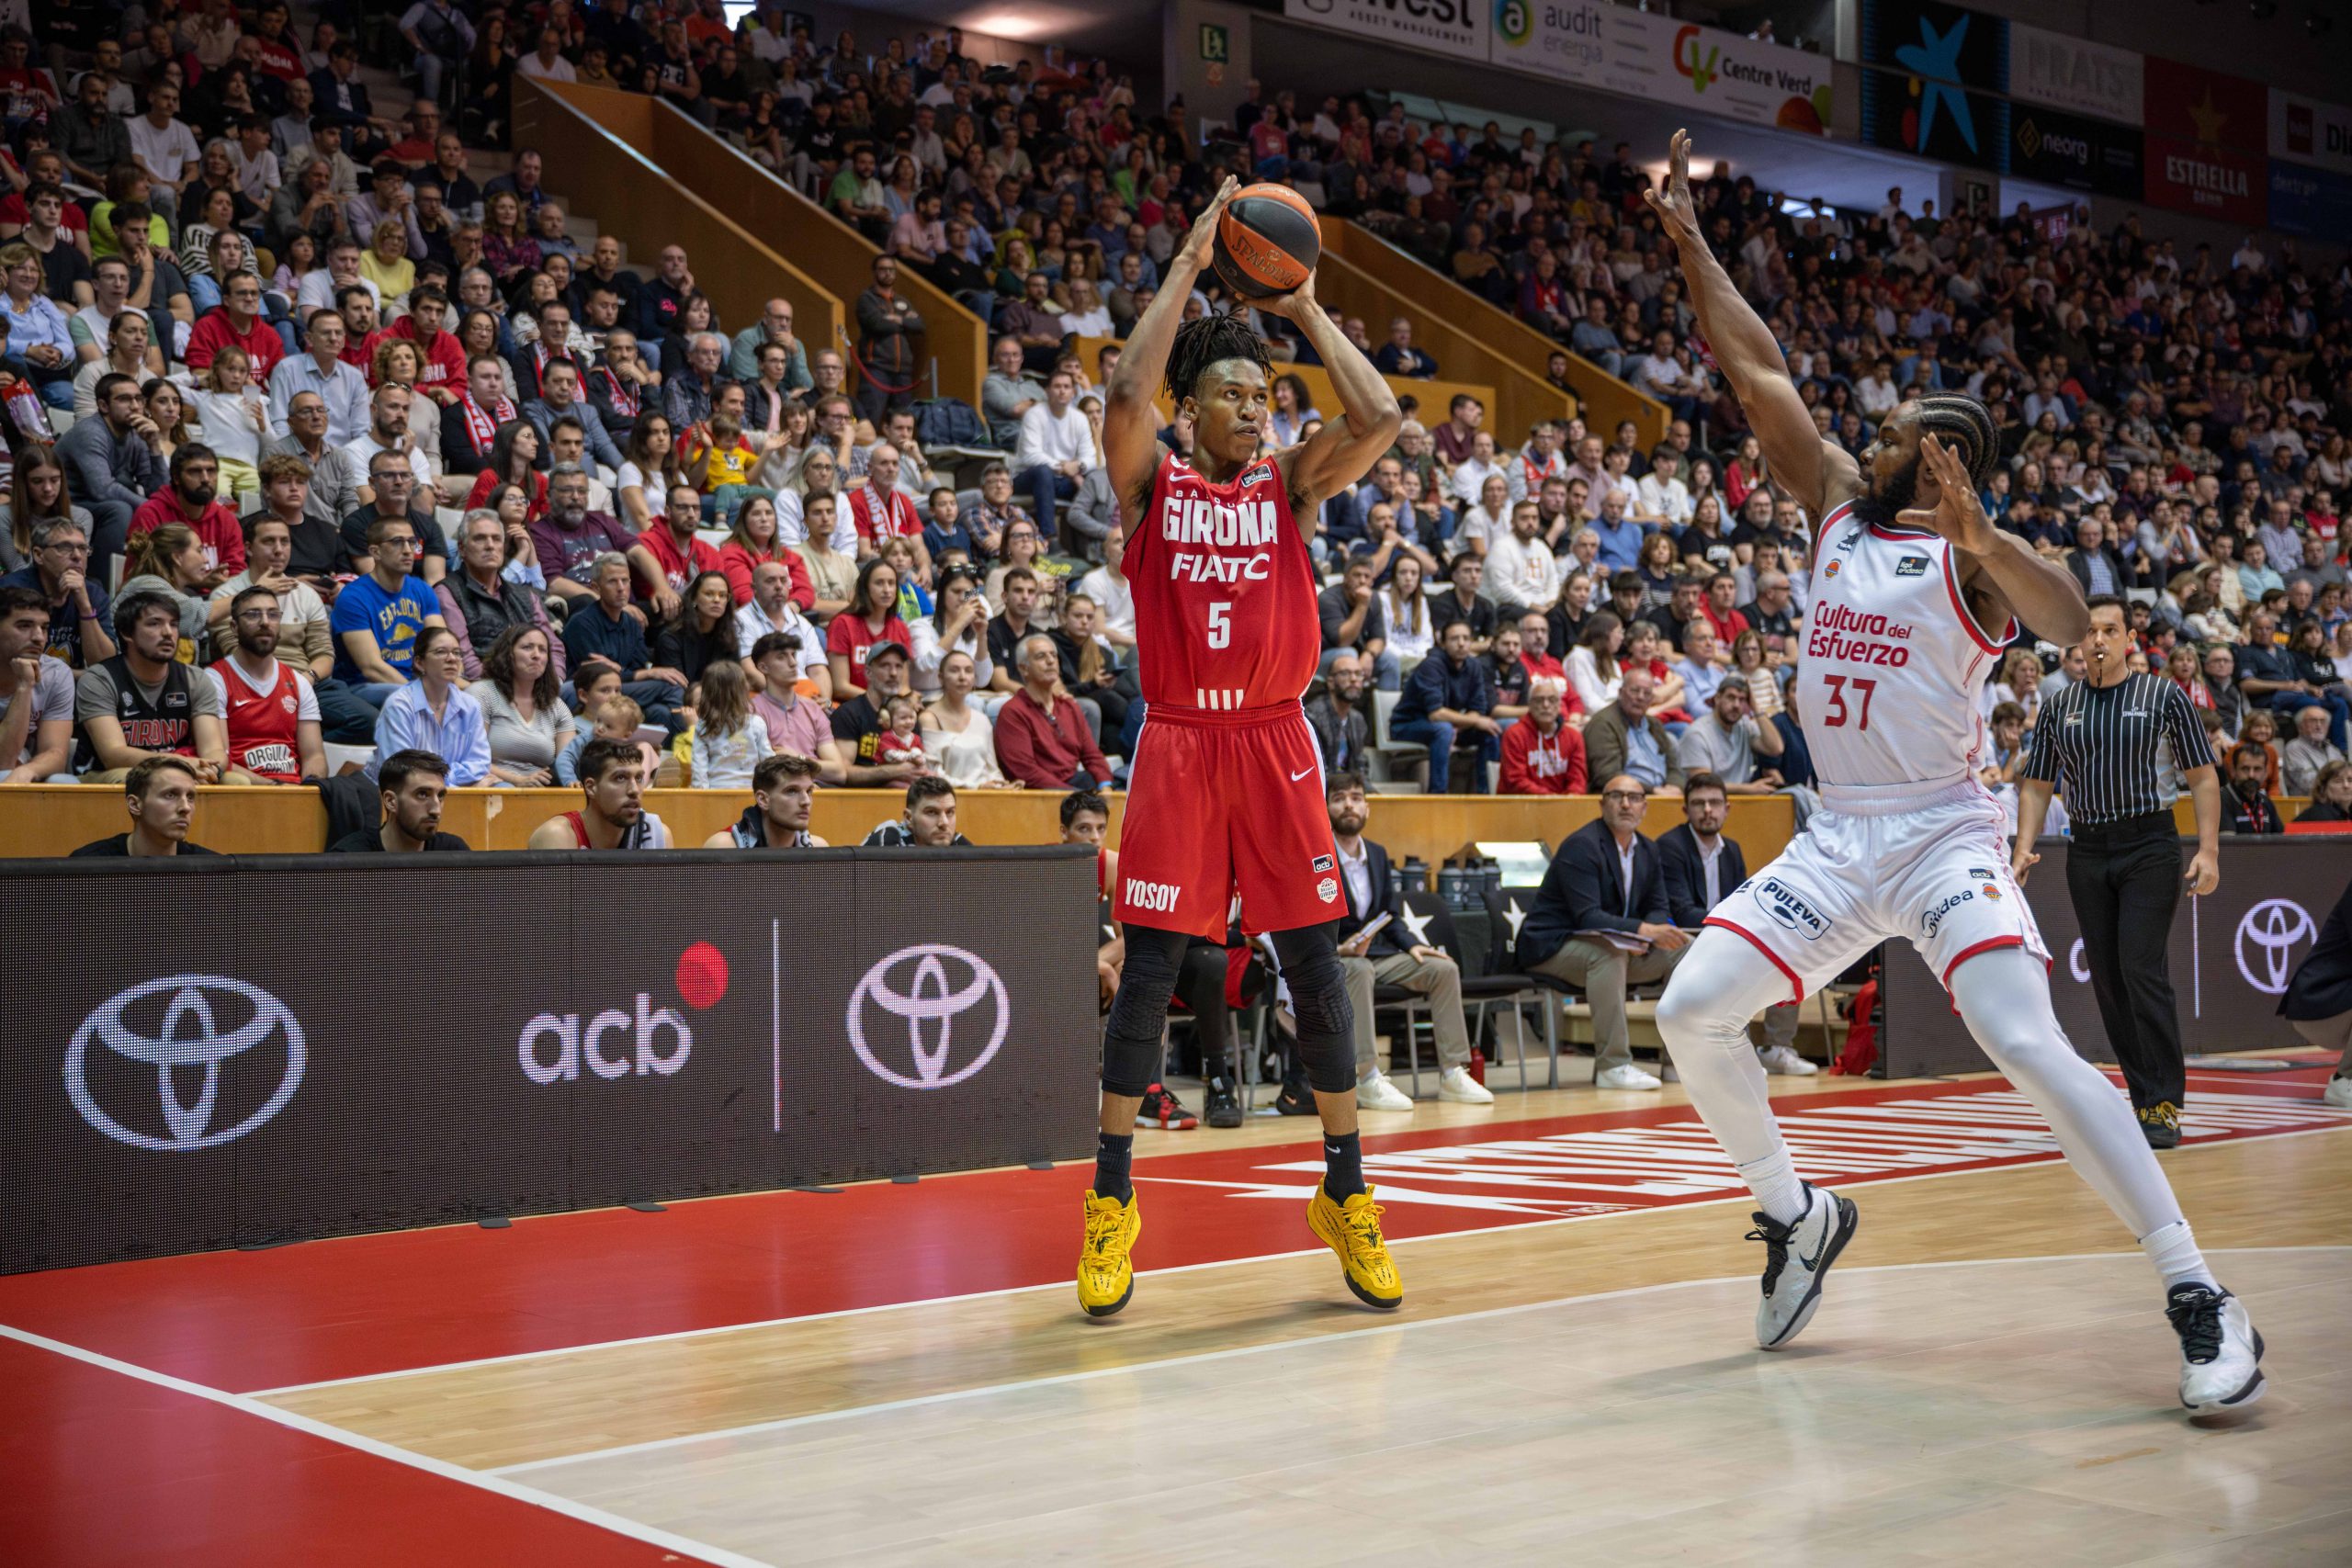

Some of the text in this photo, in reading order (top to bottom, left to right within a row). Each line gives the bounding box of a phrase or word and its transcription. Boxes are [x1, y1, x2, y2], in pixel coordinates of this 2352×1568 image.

[1544, 6, 1602, 39] audit
[1723, 57, 1813, 95] Centre Verd
[2165, 153, 2249, 198] ESTRELLA
[1163, 496, 1279, 547] GIRONA
[1170, 552, 1271, 583] FIATC
[1207, 602, 1231, 649] 5
[1815, 600, 1913, 640] Cultura del
[1808, 628, 1909, 668] Esfuerzo
[1824, 674, 1877, 731] 37
[1316, 860, 1330, 871] acb
[1972, 871, 1990, 879] acb
[1125, 877, 1181, 913] YOSOY
[1762, 881, 1822, 932] PULEVA
[1925, 889, 1974, 935] Midea
[518, 993, 694, 1084] acb
